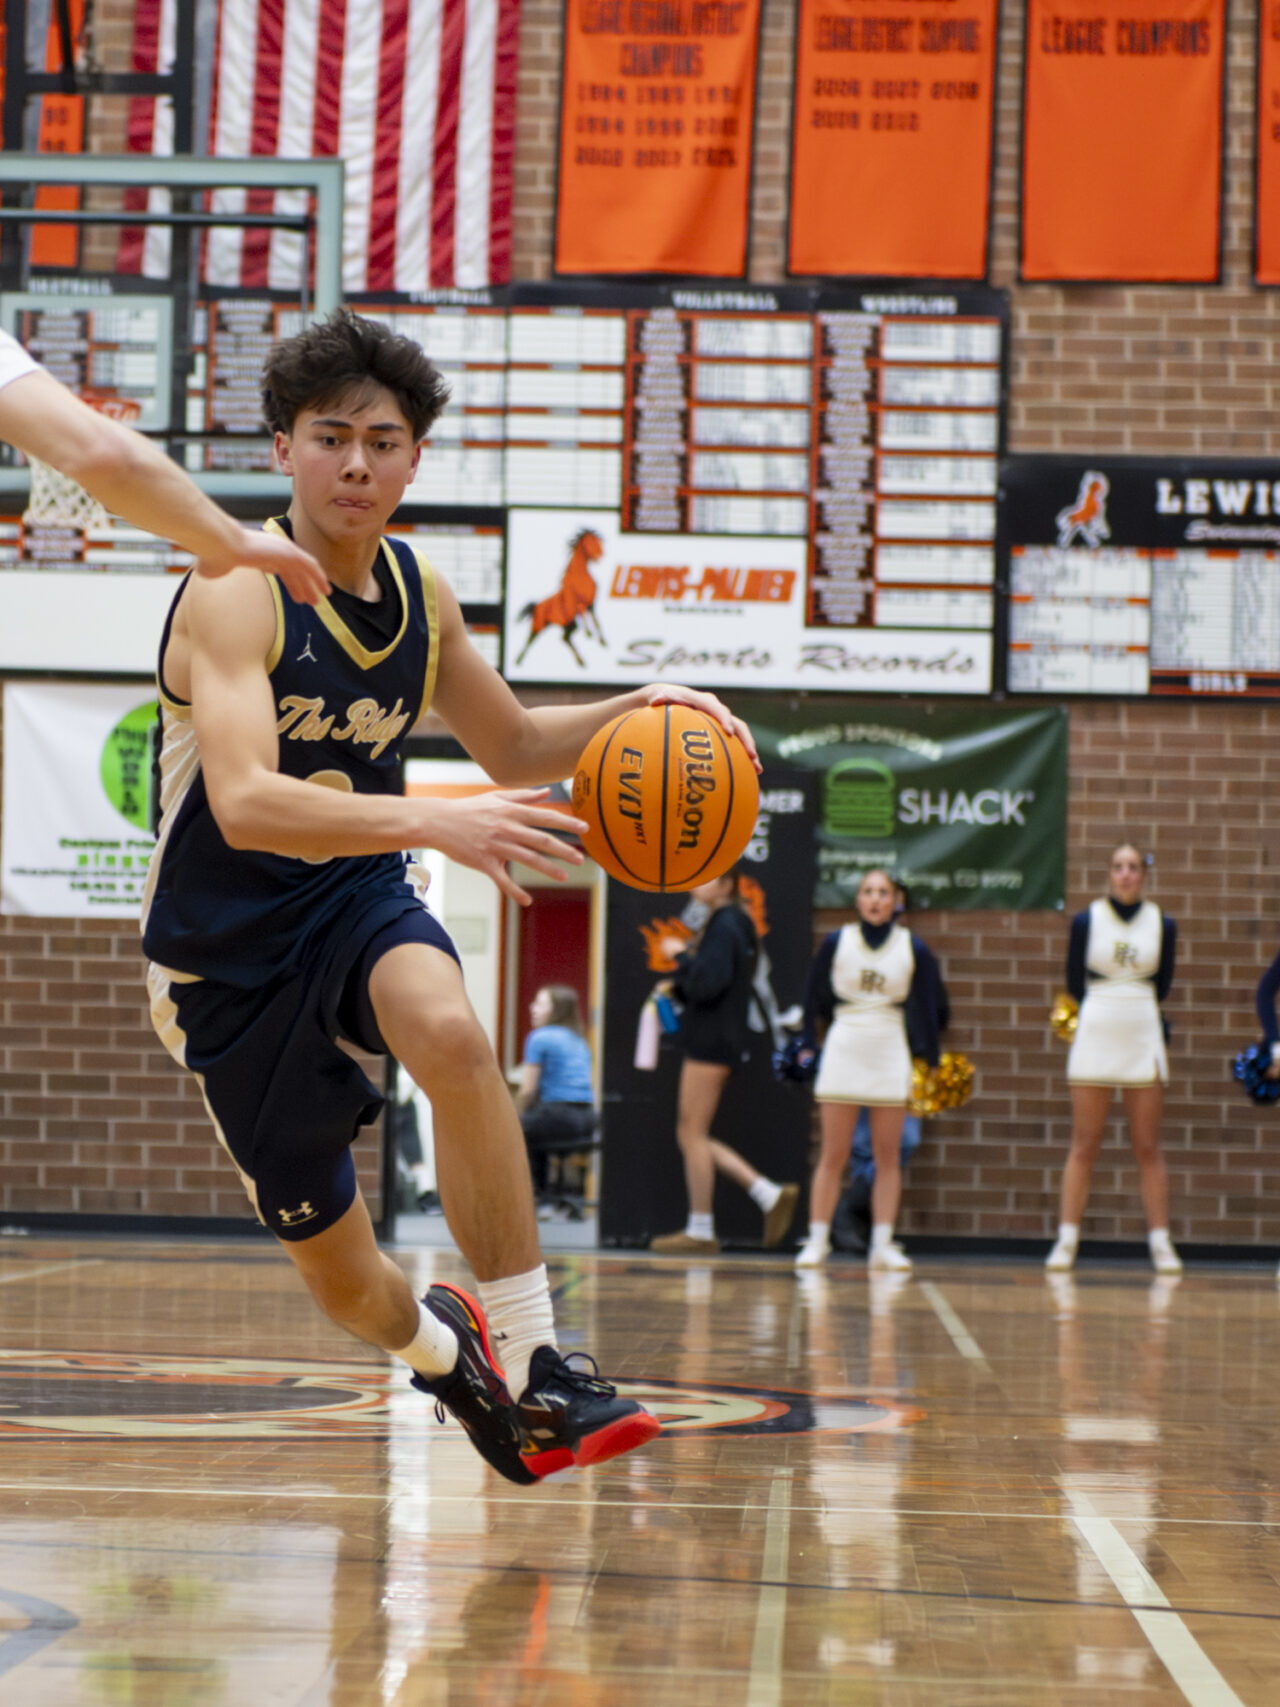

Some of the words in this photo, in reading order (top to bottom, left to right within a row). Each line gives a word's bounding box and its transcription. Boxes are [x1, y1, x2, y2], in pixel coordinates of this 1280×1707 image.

[616, 640, 772, 674] Sports
[796, 643, 976, 675] Records
[676, 729, 717, 849] Wilson
[898, 788, 1026, 826] SHACK
